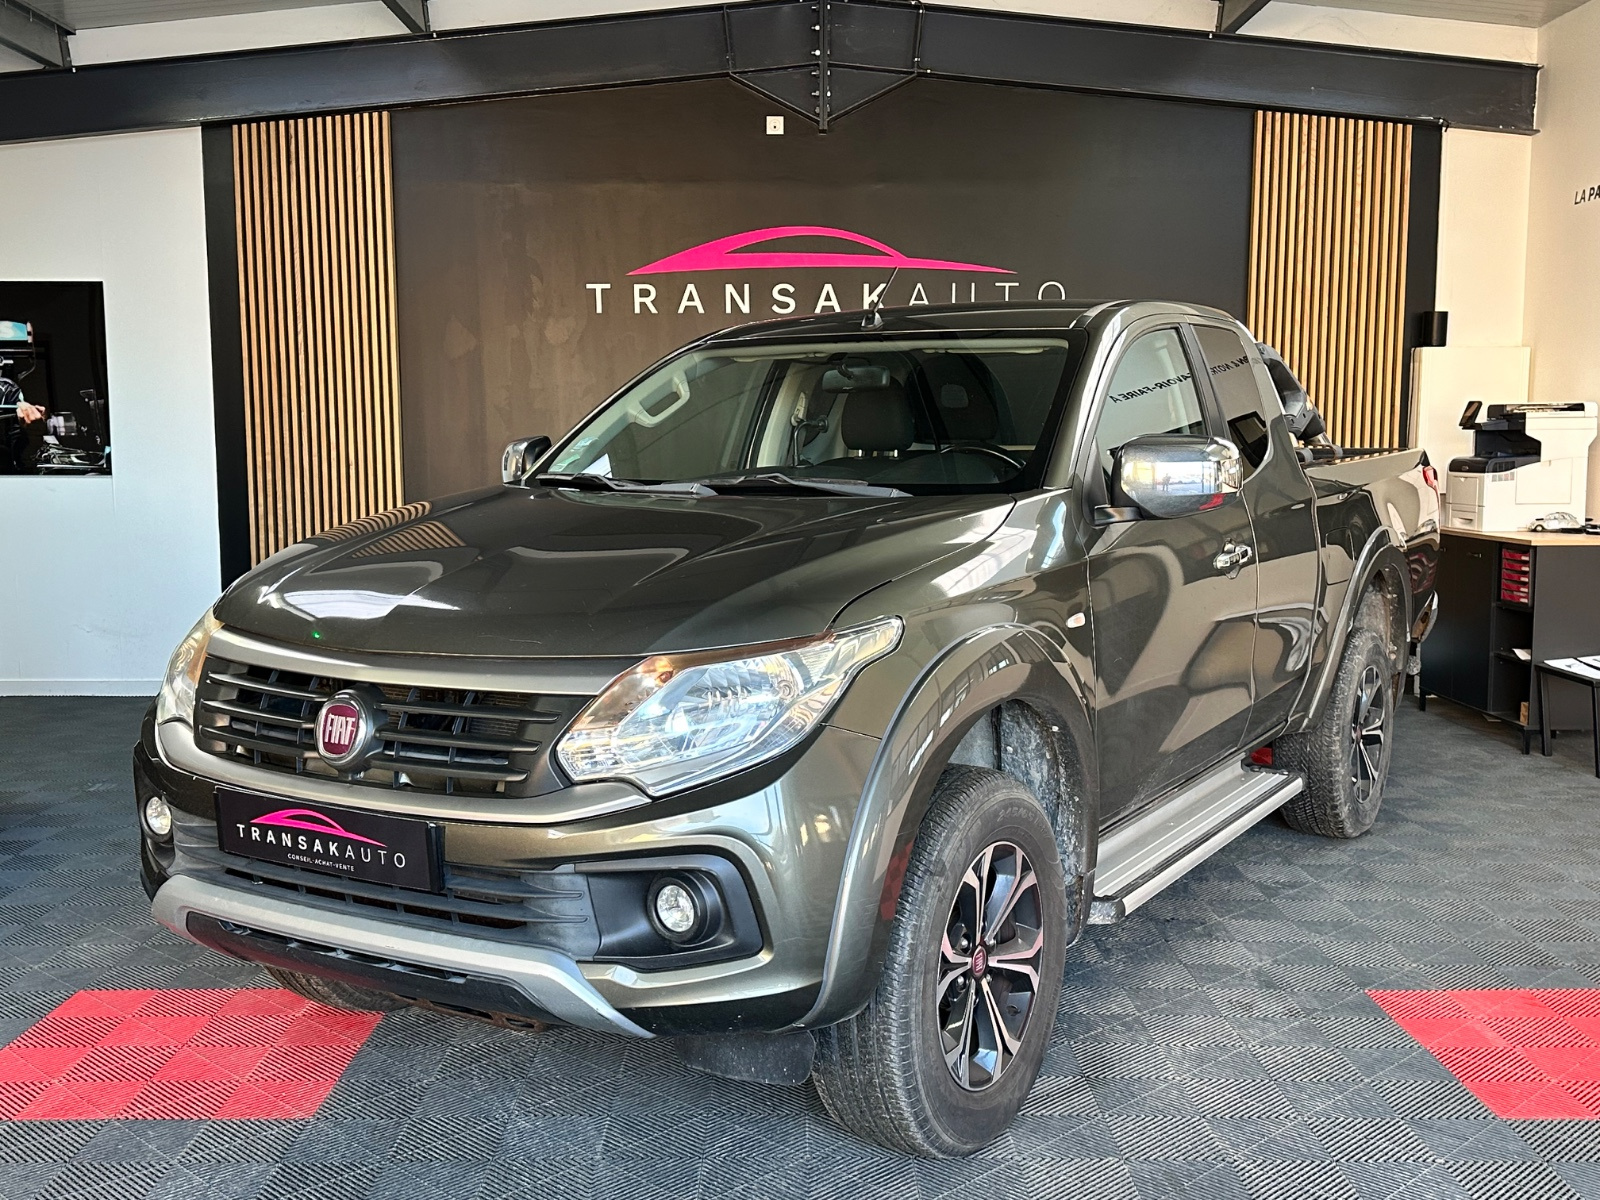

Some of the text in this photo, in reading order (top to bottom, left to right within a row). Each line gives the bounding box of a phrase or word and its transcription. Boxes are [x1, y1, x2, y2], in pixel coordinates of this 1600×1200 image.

[1574, 189, 1586, 205] LA
[324, 713, 356, 746] FIAT
[236, 823, 406, 869] TRANSAKAUTO
